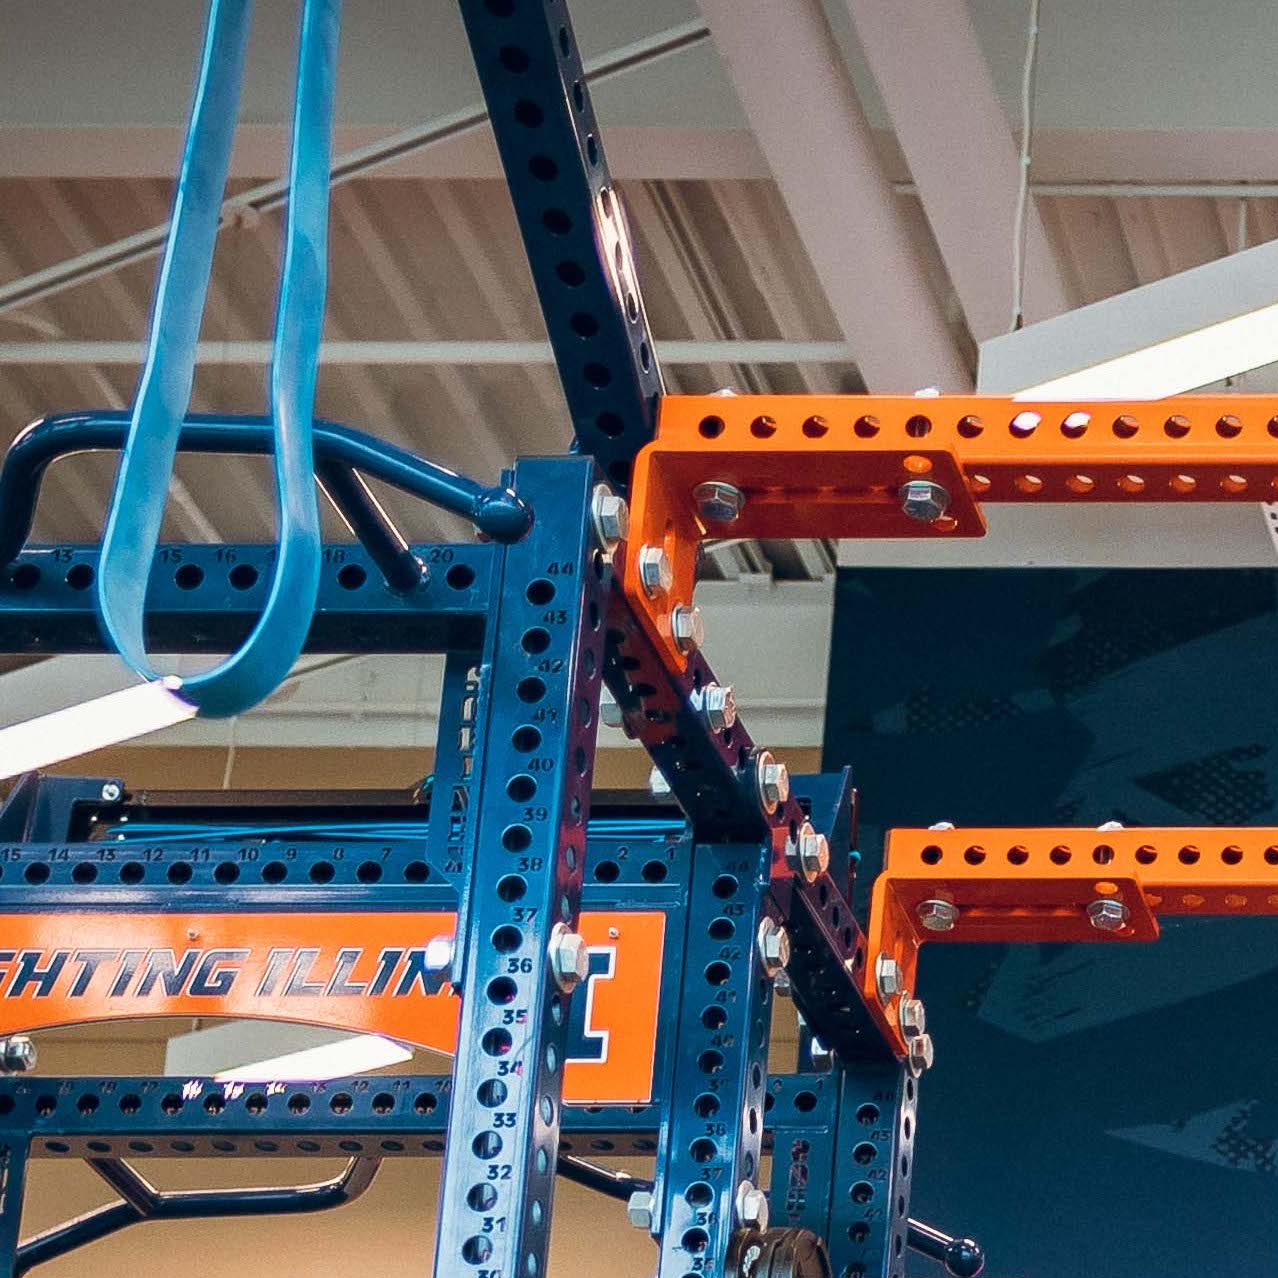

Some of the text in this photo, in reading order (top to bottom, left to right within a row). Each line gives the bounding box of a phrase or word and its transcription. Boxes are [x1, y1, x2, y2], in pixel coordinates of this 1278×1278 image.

[52, 549, 454, 563] 13 15 16 18 20
[546, 562, 574, 575] 44
[542, 612, 567, 625] 43
[527, 758, 553, 772] 40
[523, 810, 548, 823] 39
[1, 848, 20, 861] 15
[48, 848, 69, 861] 14
[97, 848, 116, 861] 13
[144, 848, 163, 861] 12
[191, 848, 210, 861] 11
[239, 848, 259, 861] 10
[286, 848, 297, 860] 9
[619, 848, 628, 860] 2
[518, 858, 543, 871] 38
[513, 908, 537, 922] 37
[254, 947, 461, 998] ILLIN
[507, 959, 532, 973] 36
[503, 1009, 527, 1024] 35
[497, 1060, 522, 1075] 34
[493, 1113, 517, 1127] 33
[487, 1165, 512, 1179] 32
[700, 1167, 722, 1180] 37
[482, 1217, 505, 1232] 31
[696, 1212, 717, 1225] 36
